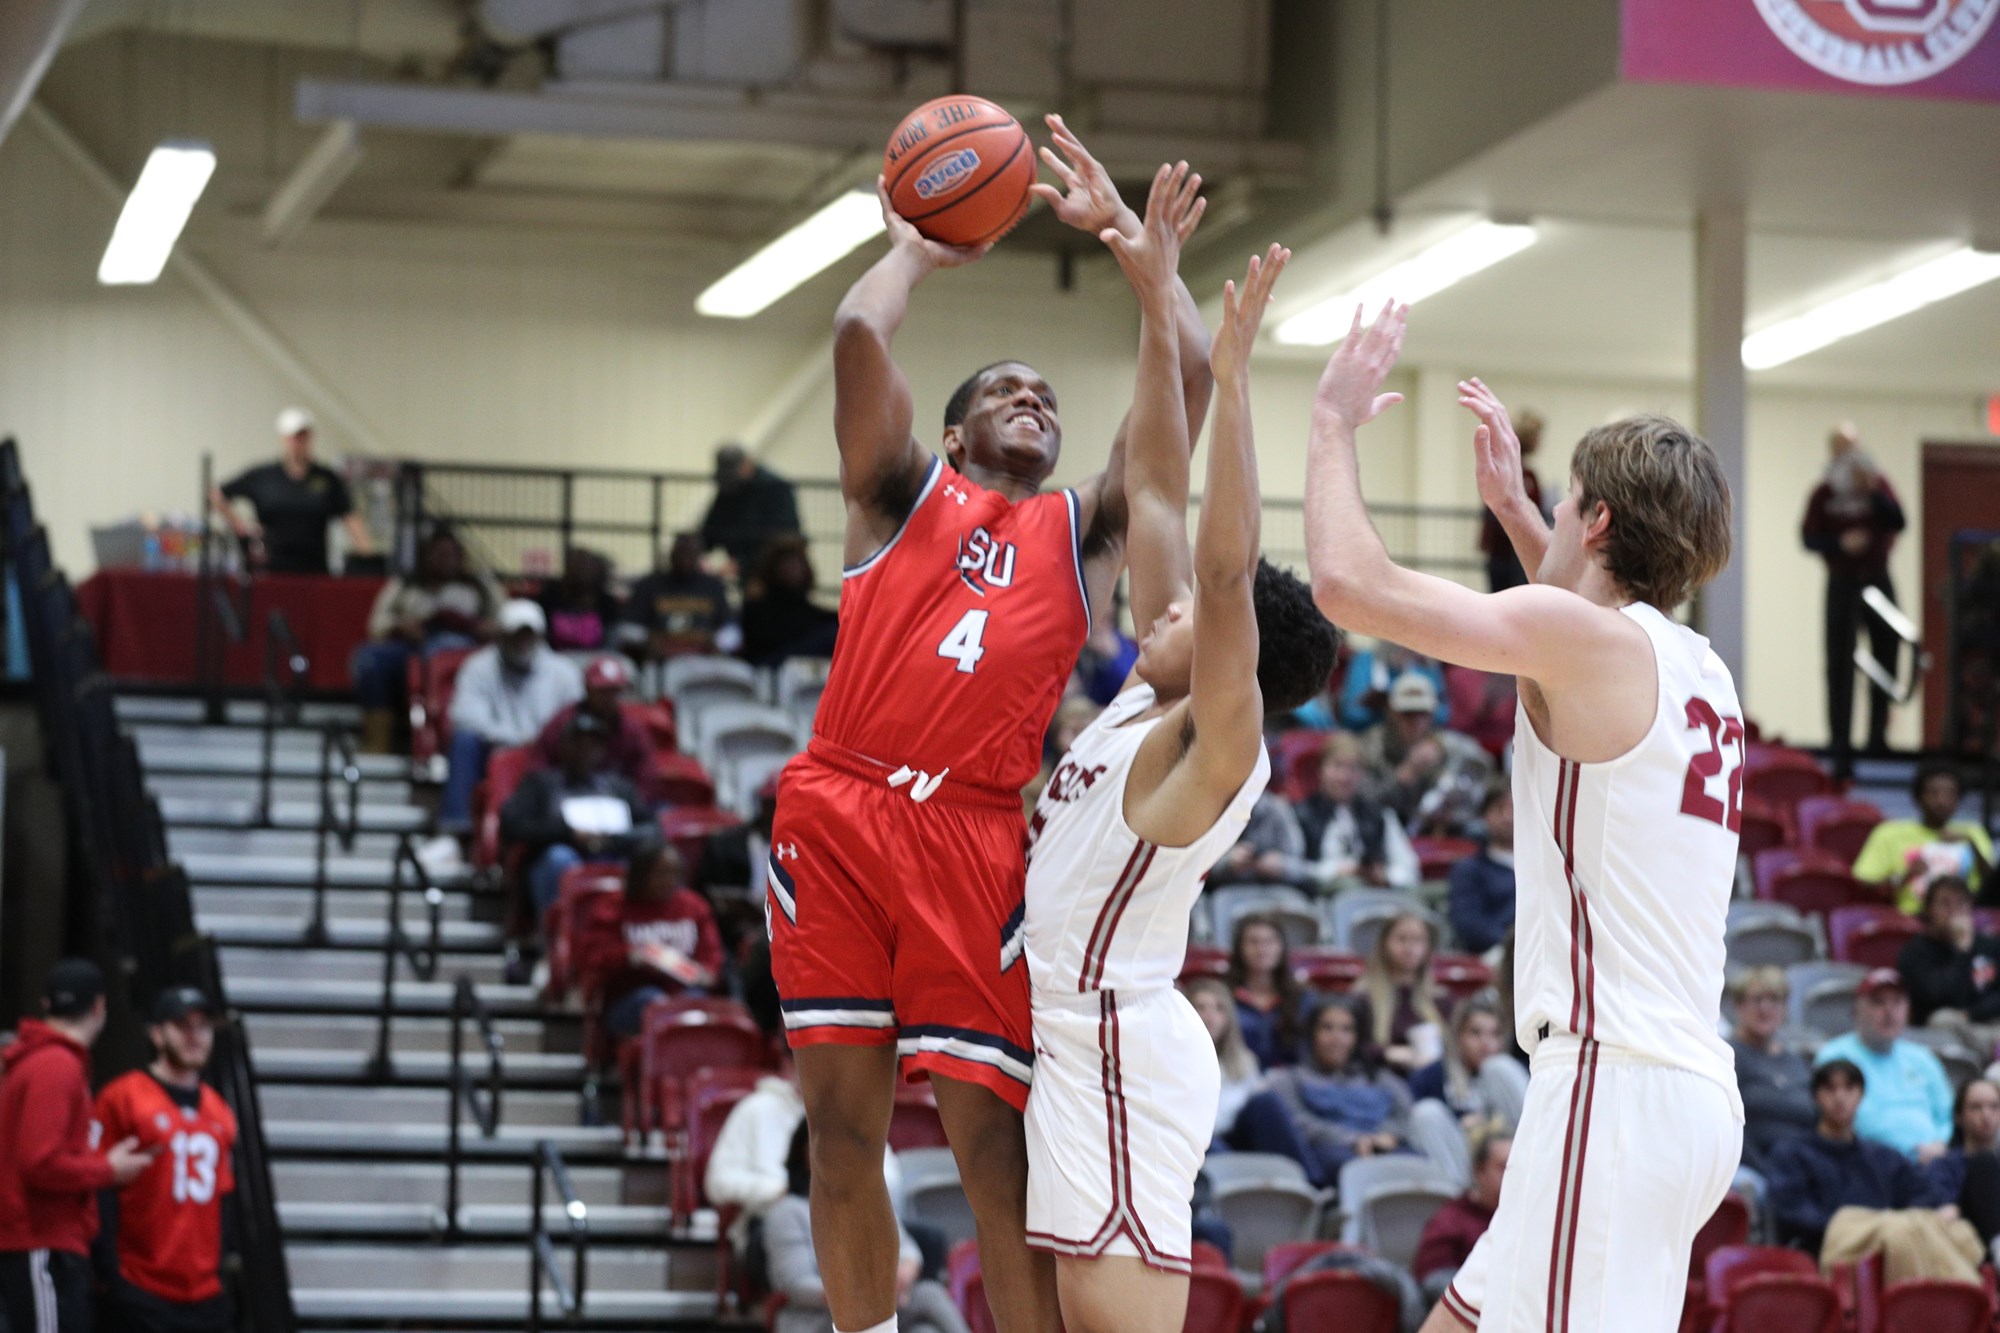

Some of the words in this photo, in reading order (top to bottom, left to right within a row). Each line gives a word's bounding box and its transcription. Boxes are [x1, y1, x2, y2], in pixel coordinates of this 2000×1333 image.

[932, 103, 979, 129] THE
[916, 149, 978, 195] ODAC
[959, 526, 1016, 589] SU
[937, 608, 990, 674] 4
[1680, 696, 1744, 834] 22
[171, 1130, 220, 1204] 13
